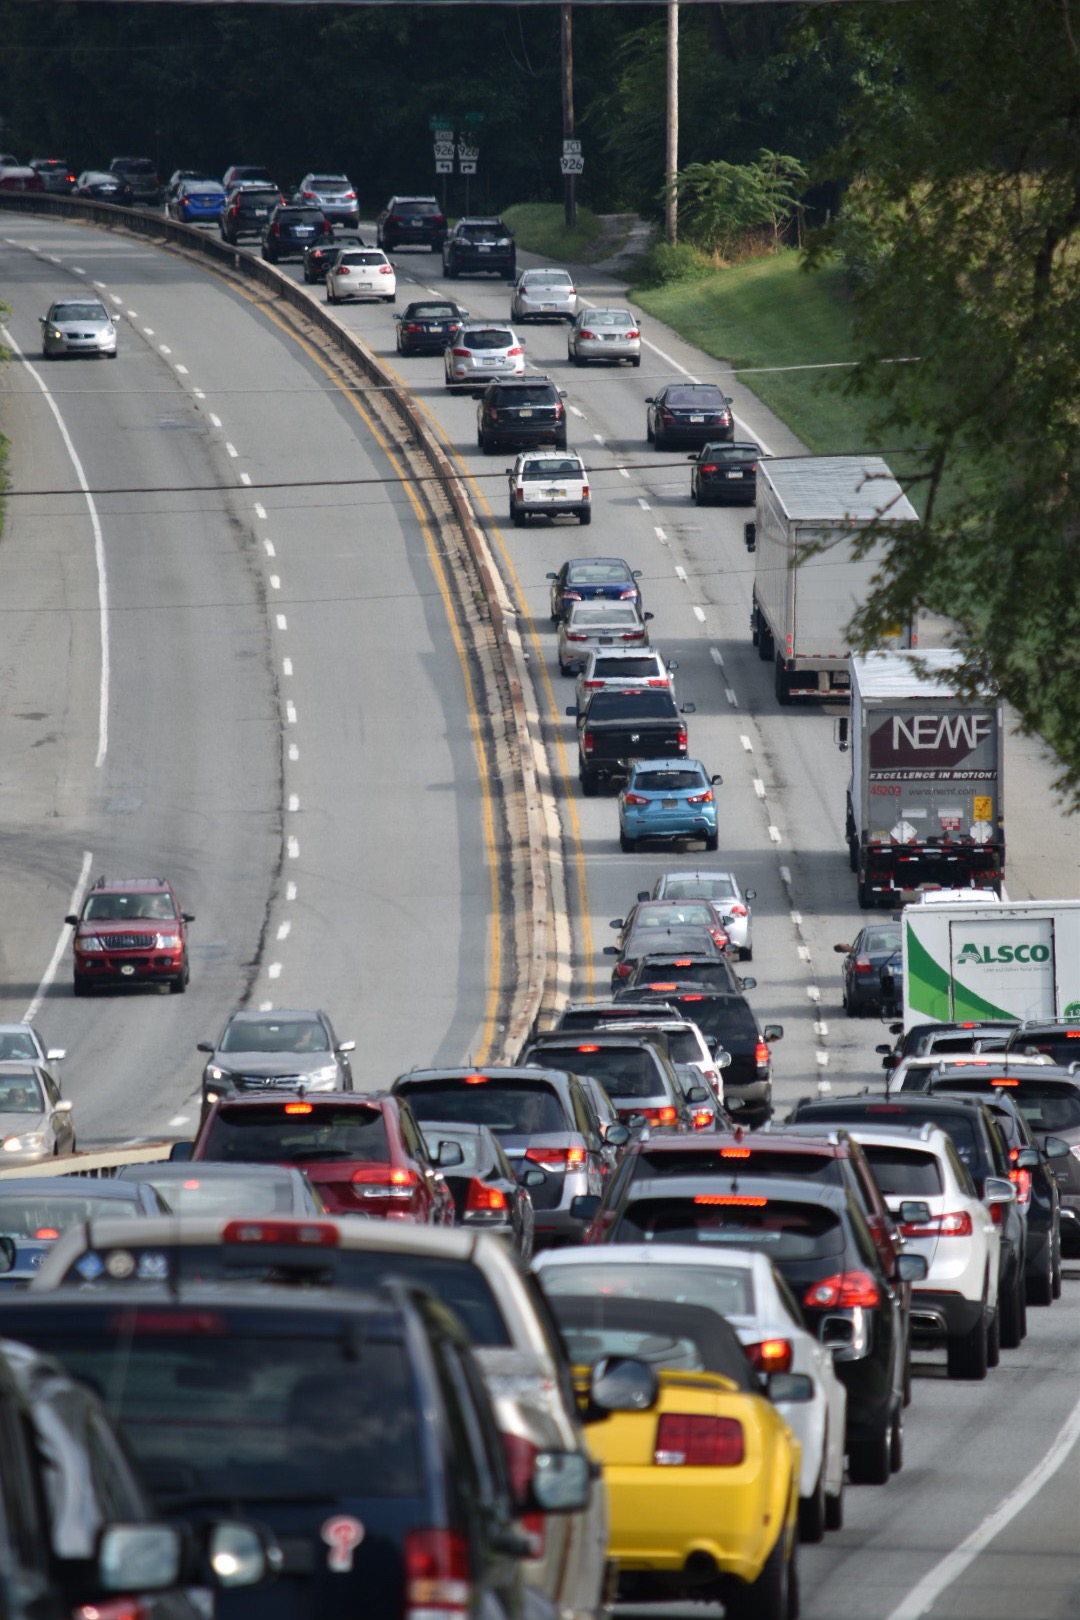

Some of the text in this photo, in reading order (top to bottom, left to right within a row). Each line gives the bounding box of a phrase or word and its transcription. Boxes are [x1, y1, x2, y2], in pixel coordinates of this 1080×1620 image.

[435, 145, 454, 156] 926
[459, 146, 478, 156] 926
[565, 142, 581, 151] JCT
[562, 159, 582, 169] 926
[869, 771, 997, 780] EXCELLENCE IN MOTION!
[955, 943, 1050, 964] ALSCO
